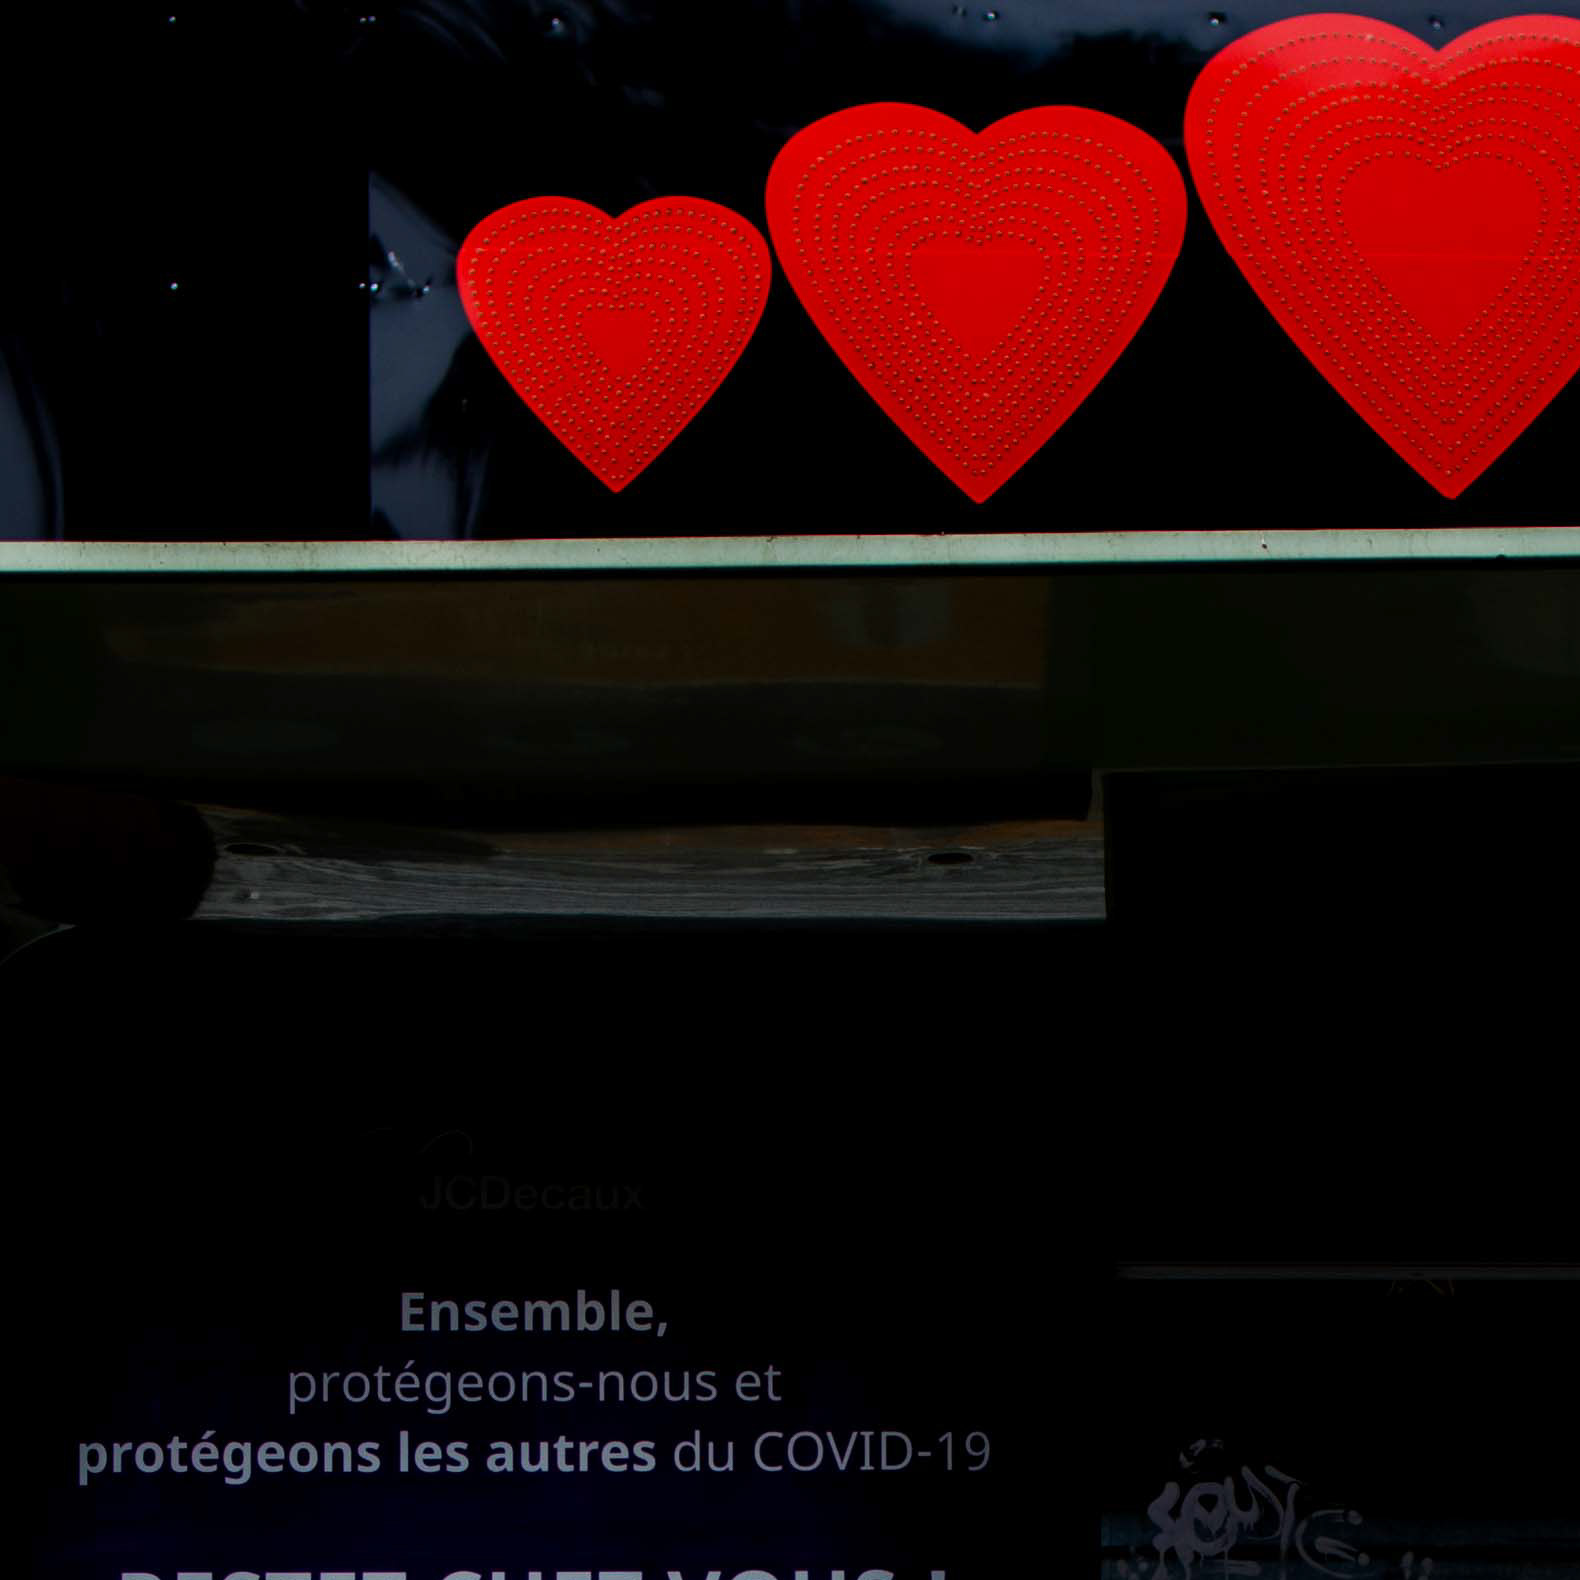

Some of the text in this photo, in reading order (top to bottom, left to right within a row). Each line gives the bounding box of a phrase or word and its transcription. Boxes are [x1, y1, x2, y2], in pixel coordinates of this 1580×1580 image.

[418, 1174, 645, 1213] JCDecaux
[401, 1288, 668, 1337] Ensemble,
[289, 1359, 782, 1415] protégeons-nous et
[79, 1429, 990, 1486] protégeons les autres du COVID-19
